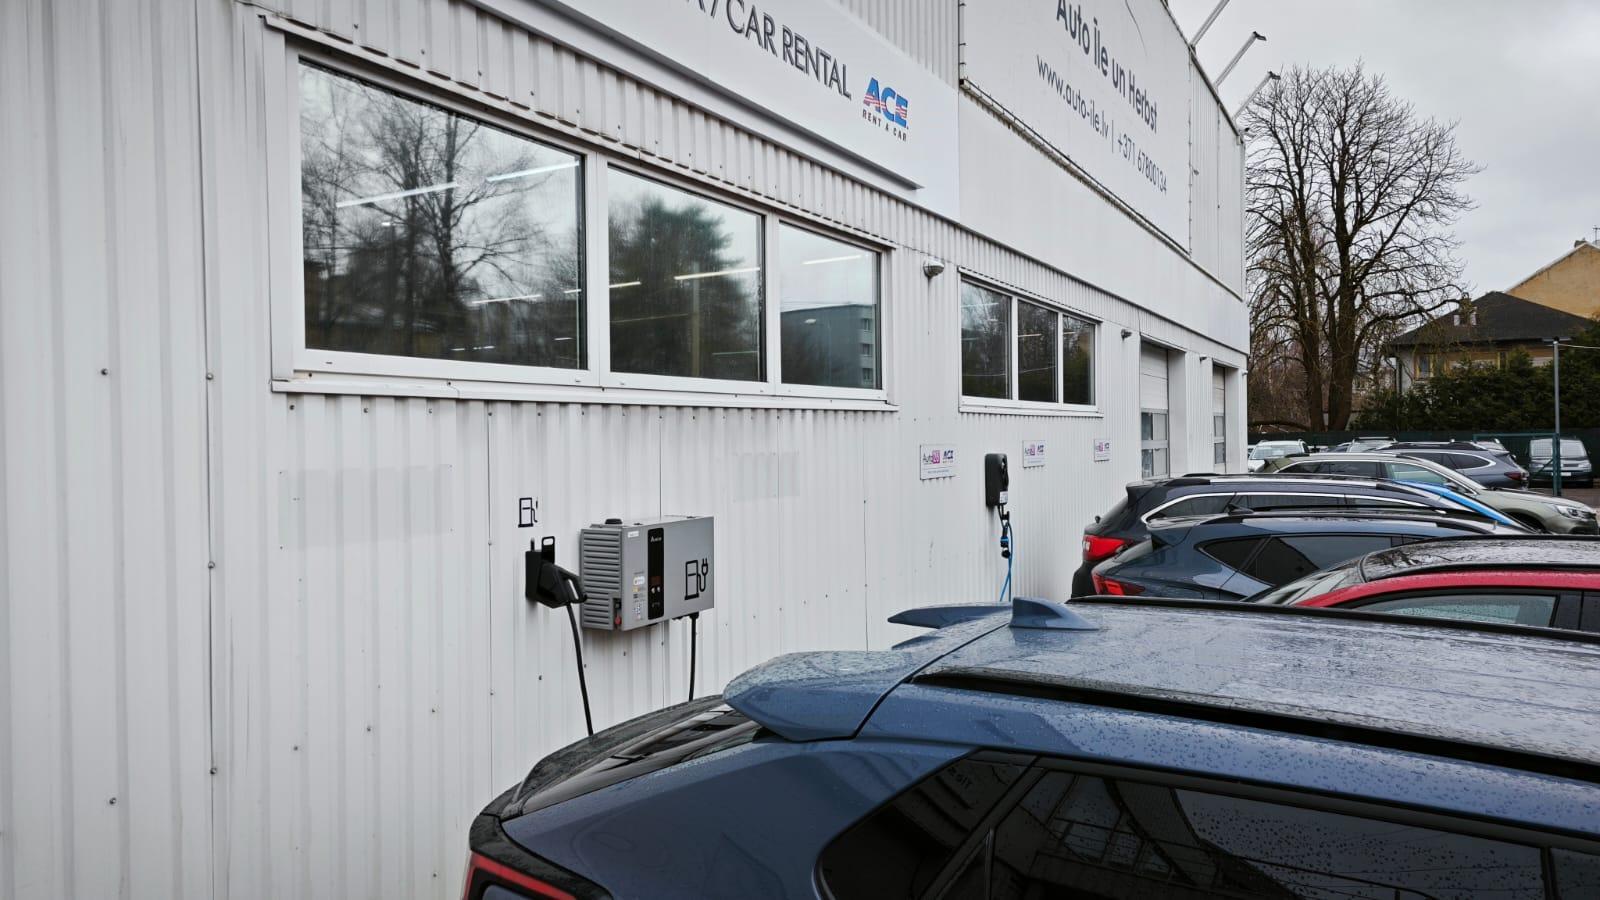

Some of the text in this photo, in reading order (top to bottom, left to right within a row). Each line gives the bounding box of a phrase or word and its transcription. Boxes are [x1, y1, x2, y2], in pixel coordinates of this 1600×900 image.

[726, 0, 852, 100] CAR RENTAL
[1056, 0, 1090, 55] Auto
[1112, 58, 1126, 98] un
[1129, 69, 1157, 134] Herbst
[862, 109, 907, 141] RENT A CAR
[863, 77, 908, 128] ACE
[1036, 54, 1109, 139] www.auto-ile.lv
[1118, 132, 1136, 166] +371
